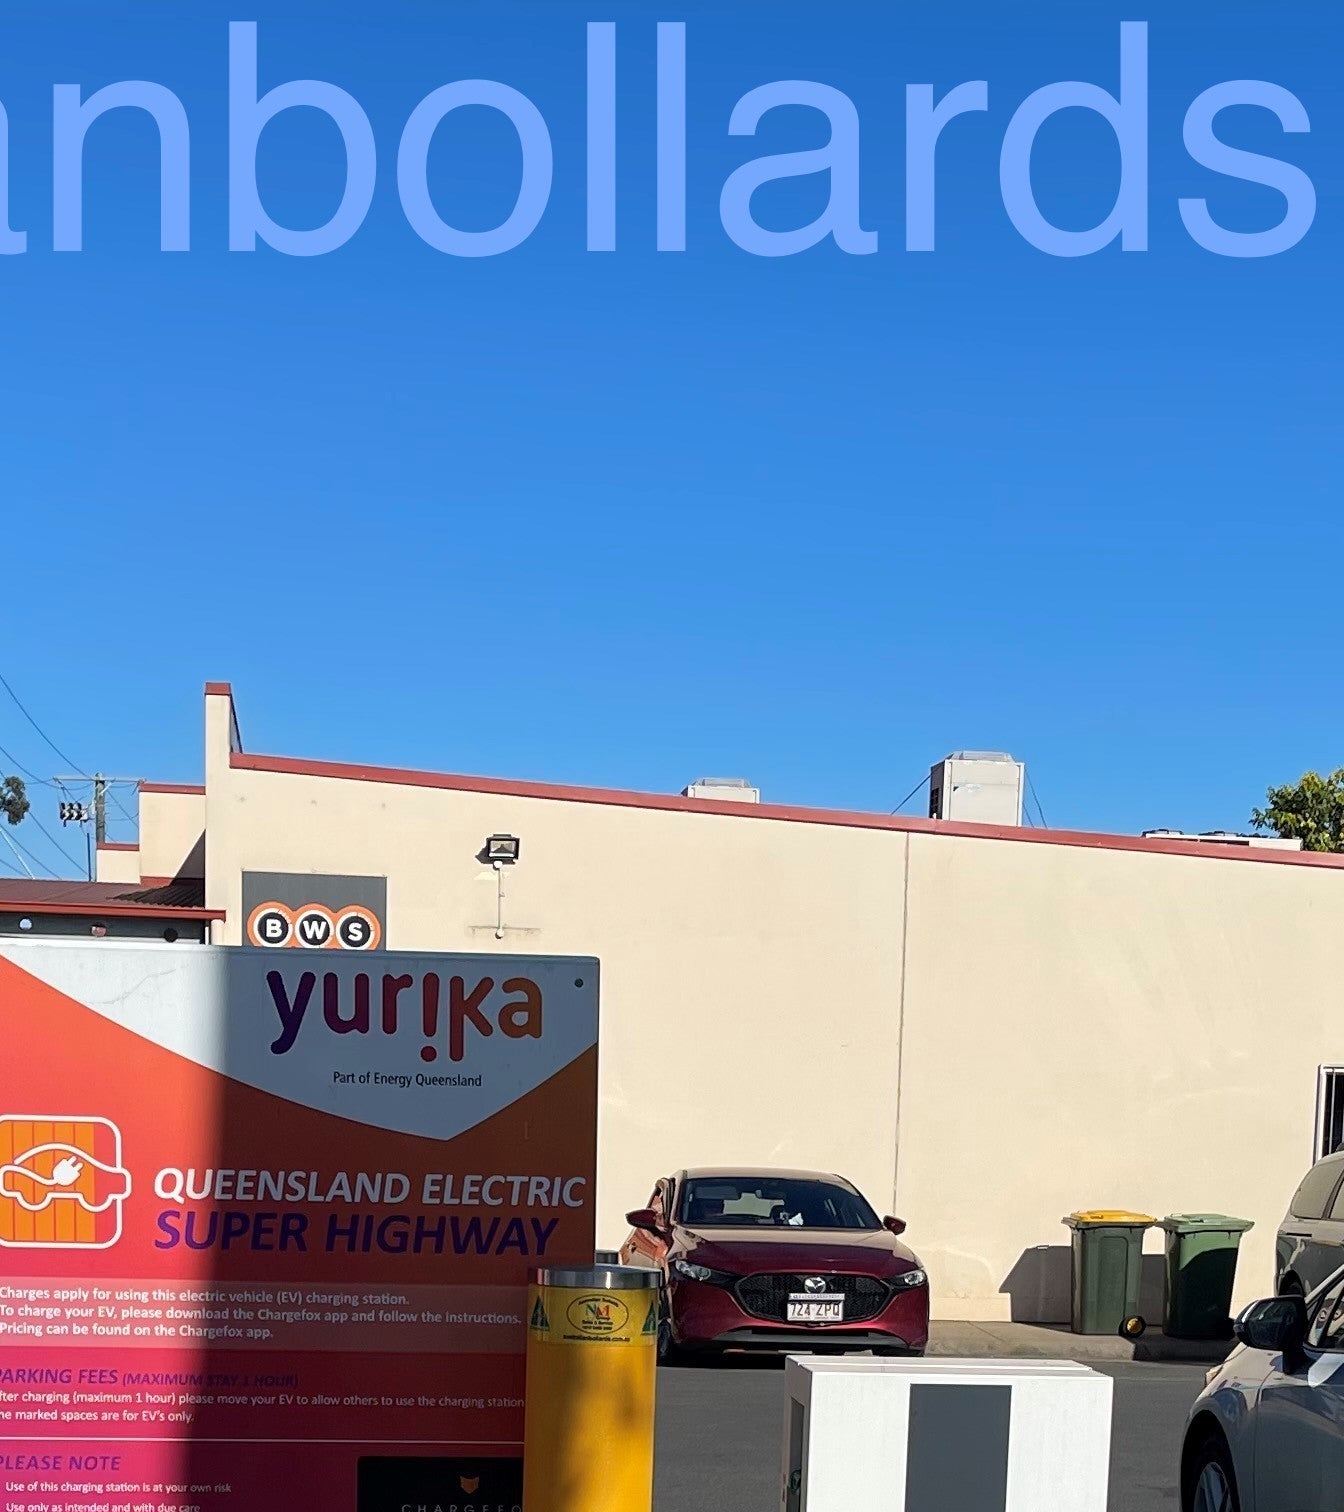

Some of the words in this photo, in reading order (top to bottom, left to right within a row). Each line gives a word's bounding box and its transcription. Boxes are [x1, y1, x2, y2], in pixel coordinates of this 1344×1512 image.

[333, 1071, 356, 1086] Part
[359, 1071, 370, 1086] of
[374, 1072, 412, 1089] Energy
[415, 1073, 482, 1088] Queensland
[155, 1168, 410, 1205] QUEENSLAND
[423, 1173, 586, 1209] ELECTRIC
[155, 1210, 309, 1250] SUPER
[326, 1214, 559, 1255] HIGHWAY
[0, 1287, 49, 1300] Charges
[54, 1289, 88, 1301] apply
[93, 1288, 111, 1300] for
[115, 1290, 148, 1302] using
[153, 1289, 175, 1301] this
[179, 1290, 225, 1301] electric
[229, 1291, 272, 1302] vehicle
[277, 1292, 302, 1305] (EV)
[306, 1292, 359, 1306] charging
[363, 1293, 409, 1305] station.
[0, 1305, 13, 1316] To
[18, 1306, 60, 1319] charge
[65, 1309, 94, 1319] your
[98, 1307, 117, 1319] EV,
[122, 1307, 162, 1320] please
[166, 1308, 229, 1320] download
[233, 1308, 254, 1320] the
[258, 1309, 320, 1322] Chargefox
[324, 1312, 347, 1323] app
[352, 1310, 374, 1322] and
[379, 1311, 418, 1322] follow
[421, 1311, 442, 1322] the
[446, 1312, 521, 1323] instructions.
[791, 1303, 810, 1316] 724
[0, 1322, 43, 1336] Pricing
[47, 1326, 68, 1335] can
[73, 1323, 88, 1335] be
[92, 1324, 130, 1336] found
[134, 1327, 150, 1336] on
[155, 1325, 175, 1337] the
[179, 1325, 242, 1338] Chargefox
[247, 1328, 273, 1339] app.
[78, 1370, 118, 1384] FEES
[122, 1373, 201, 1386] (MAXIMUM
[22, 1391, 69, 1405] charging
[73, 1392, 132, 1405] (maximum
[136, 1393, 141, 1403] 1
[146, 1392, 175, 1405] hour)
[179, 1393, 213, 1405] please
[217, 1396, 247, 1404] move
[251, 1396, 275, 1406] your
[279, 1395, 293, 1405] EV
[297, 1396, 308, 1405] to
[312, 1395, 340, 1405] allow
[344, 1395, 378, 1405] others
[382, 1396, 392, 1405] to
[396, 1397, 414, 1406] use
[418, 1397, 435, 1406] the
[439, 1397, 484, 1408] charging
[15, 1410, 57, 1420] marked
[61, 1412, 98, 1423] spaces
[102, 1412, 119, 1421] are
[123, 1410, 138, 1421] for
[168, 1412, 194, 1423] only.
[69, 1456, 121, 1470] NOTE
[6, 1482, 24, 1491] Use
[27, 1481, 38, 1491] of
[41, 1482, 58, 1491] this
[61, 1482, 103, 1493] charging
[106, 1482, 140, 1492] station
[143, 1482, 150, 1492] is
[153, 1483, 162, 1492] at
[166, 1485, 188, 1493] your
[215, 1483, 231, 1492] risk
